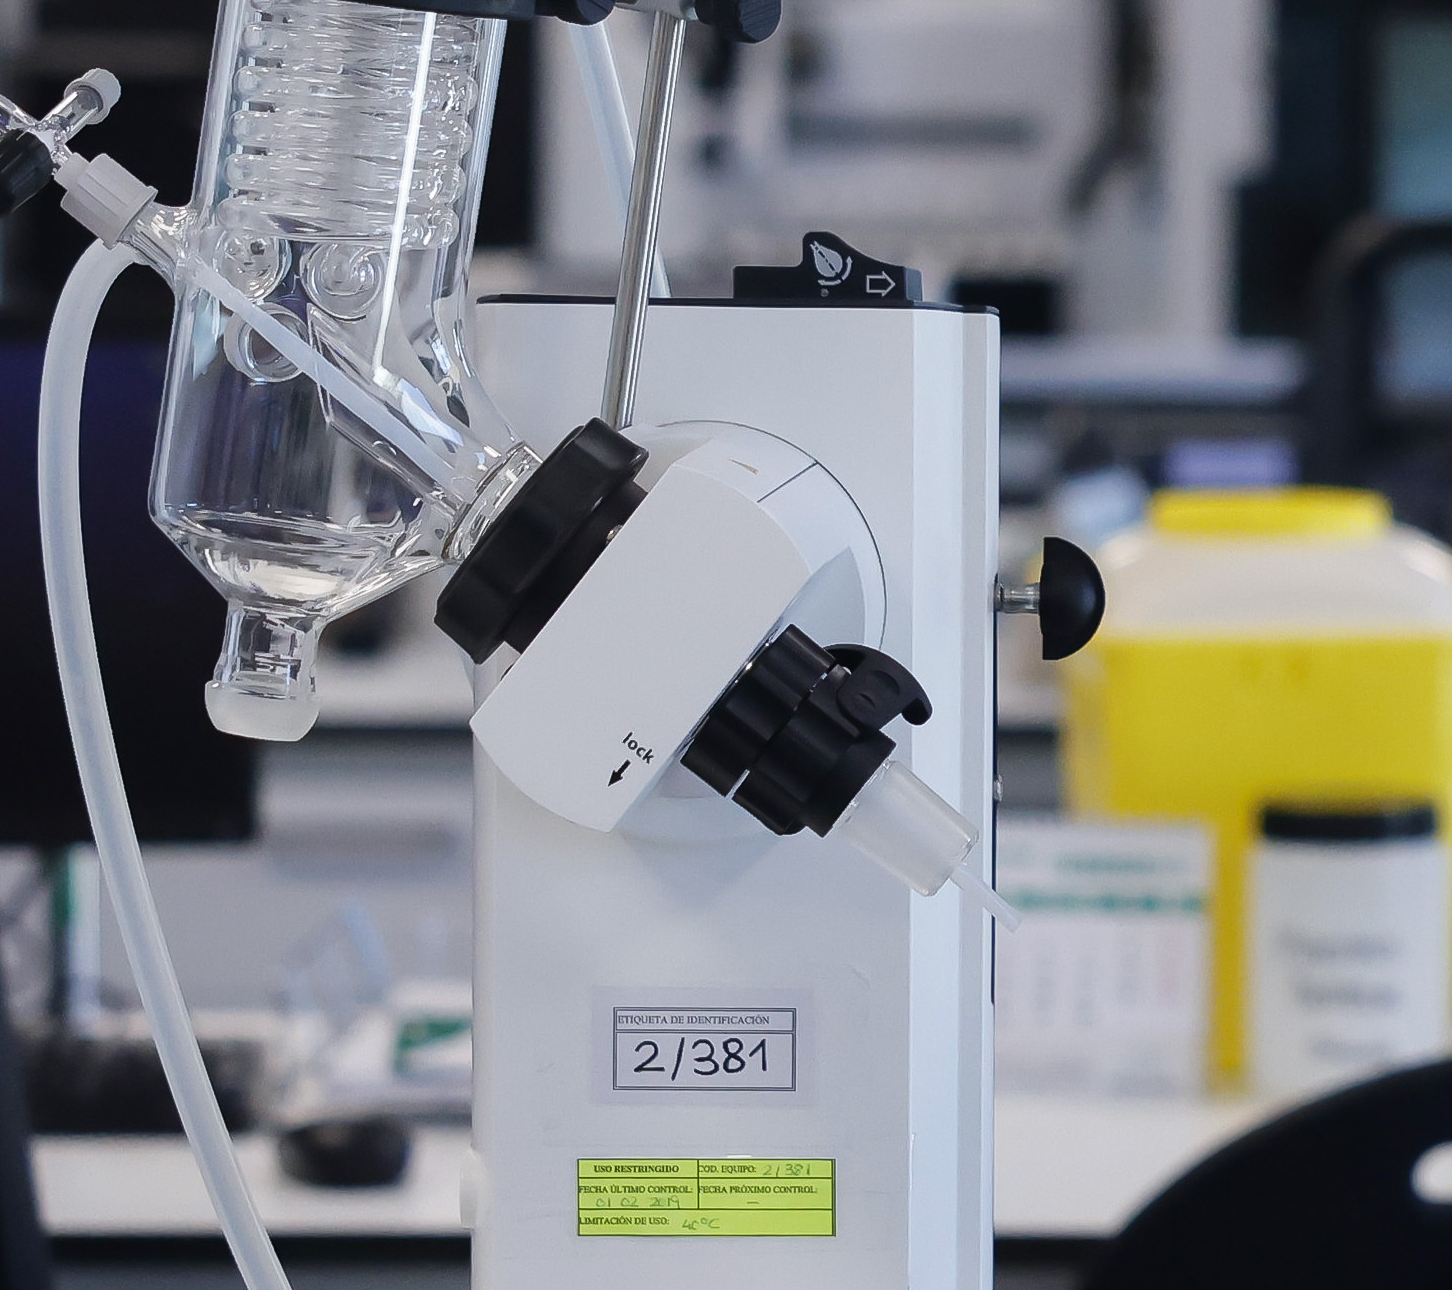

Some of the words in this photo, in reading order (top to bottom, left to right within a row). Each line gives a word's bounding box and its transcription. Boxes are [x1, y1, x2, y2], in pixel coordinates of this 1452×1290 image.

[621, 731, 654, 764] lock
[618, 1015, 668, 1026] ETIQUETA
[670, 1015, 685, 1025] DE
[686, 1013, 770, 1025] IDENTIFICACIÓN
[633, 1037, 768, 1081] 2/381
[593, 1164, 613, 1173] USO
[614, 1164, 680, 1173] RESTRINGIDO
[699, 1164, 719, 1173] COD.
[721, 1164, 757, 1174] EQUIPO:
[579, 1186, 610, 1194] FECHA
[610, 1184, 646, 1194] ÚLTIMO
[647, 1186, 694, 1194] CONTROL:
[699, 1186, 728, 1194] FECHA
[729, 1184, 771, 1194] PRÓXIMO
[773, 1186, 818, 1194] CONTROL:
[579, 1215, 632, 1225] LIMITACIÓN
[633, 1216, 647, 1225] DE
[648, 1216, 670, 1226] USO:
